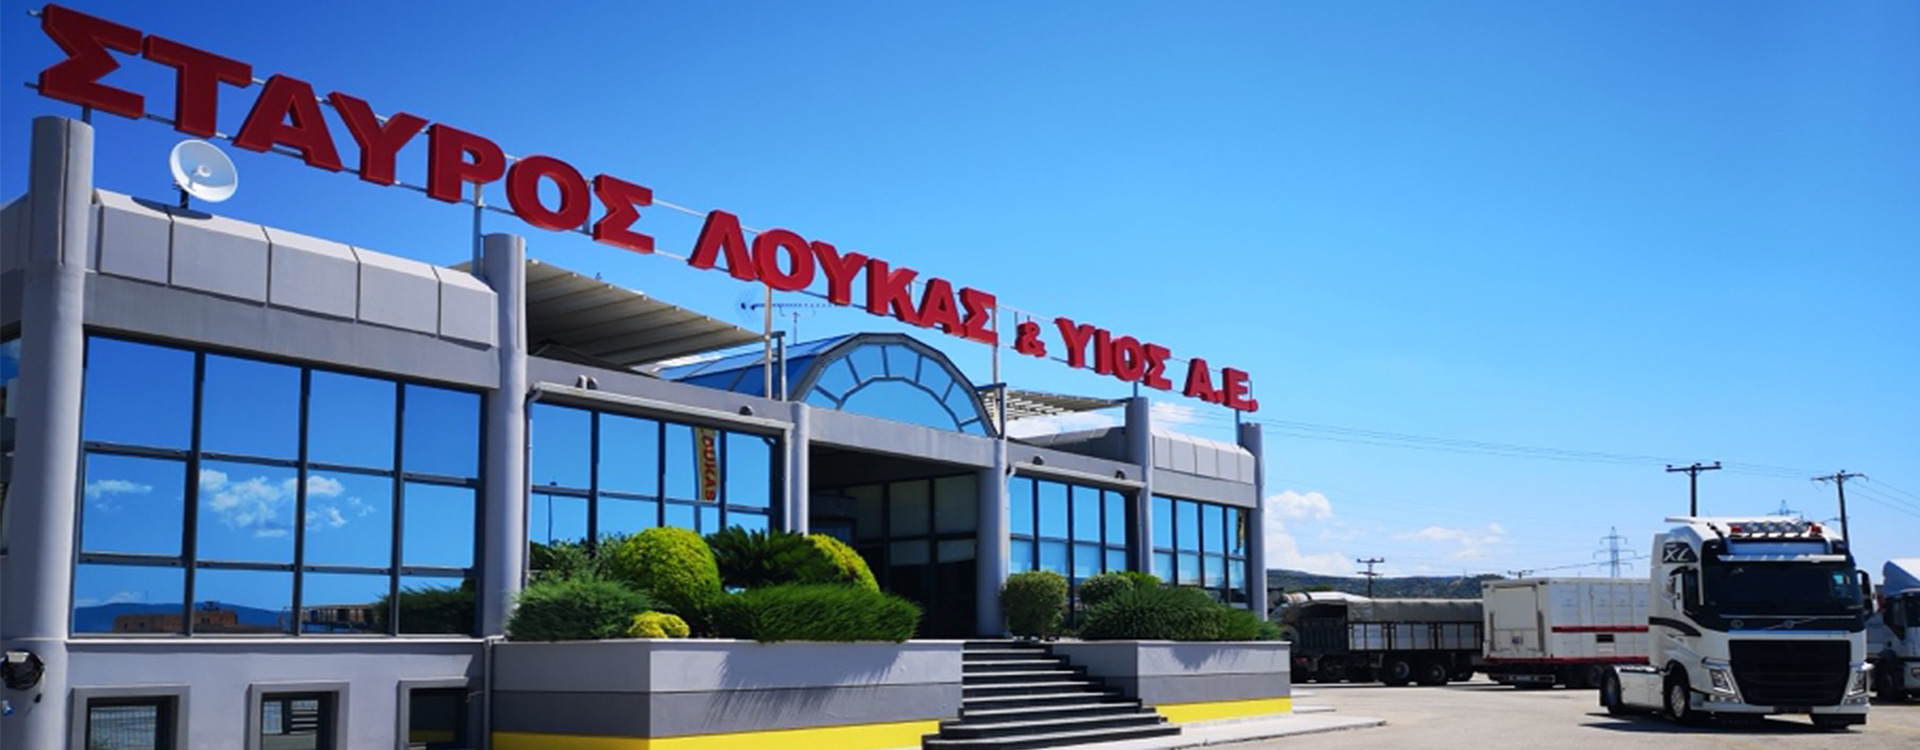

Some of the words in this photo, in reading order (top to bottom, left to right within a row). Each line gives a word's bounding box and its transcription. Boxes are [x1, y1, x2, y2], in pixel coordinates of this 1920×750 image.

[38, 3, 655, 255] ΣΤΑΥΡΟΣ
[687, 209, 999, 345] ΛΟΥΚΑΣ
[1014, 320, 1047, 358] &
[1054, 316, 1173, 391] ΥΙΟΣ
[1182, 357, 1258, 413] Α.Ε.
[702, 432, 717, 502] OUKAS
